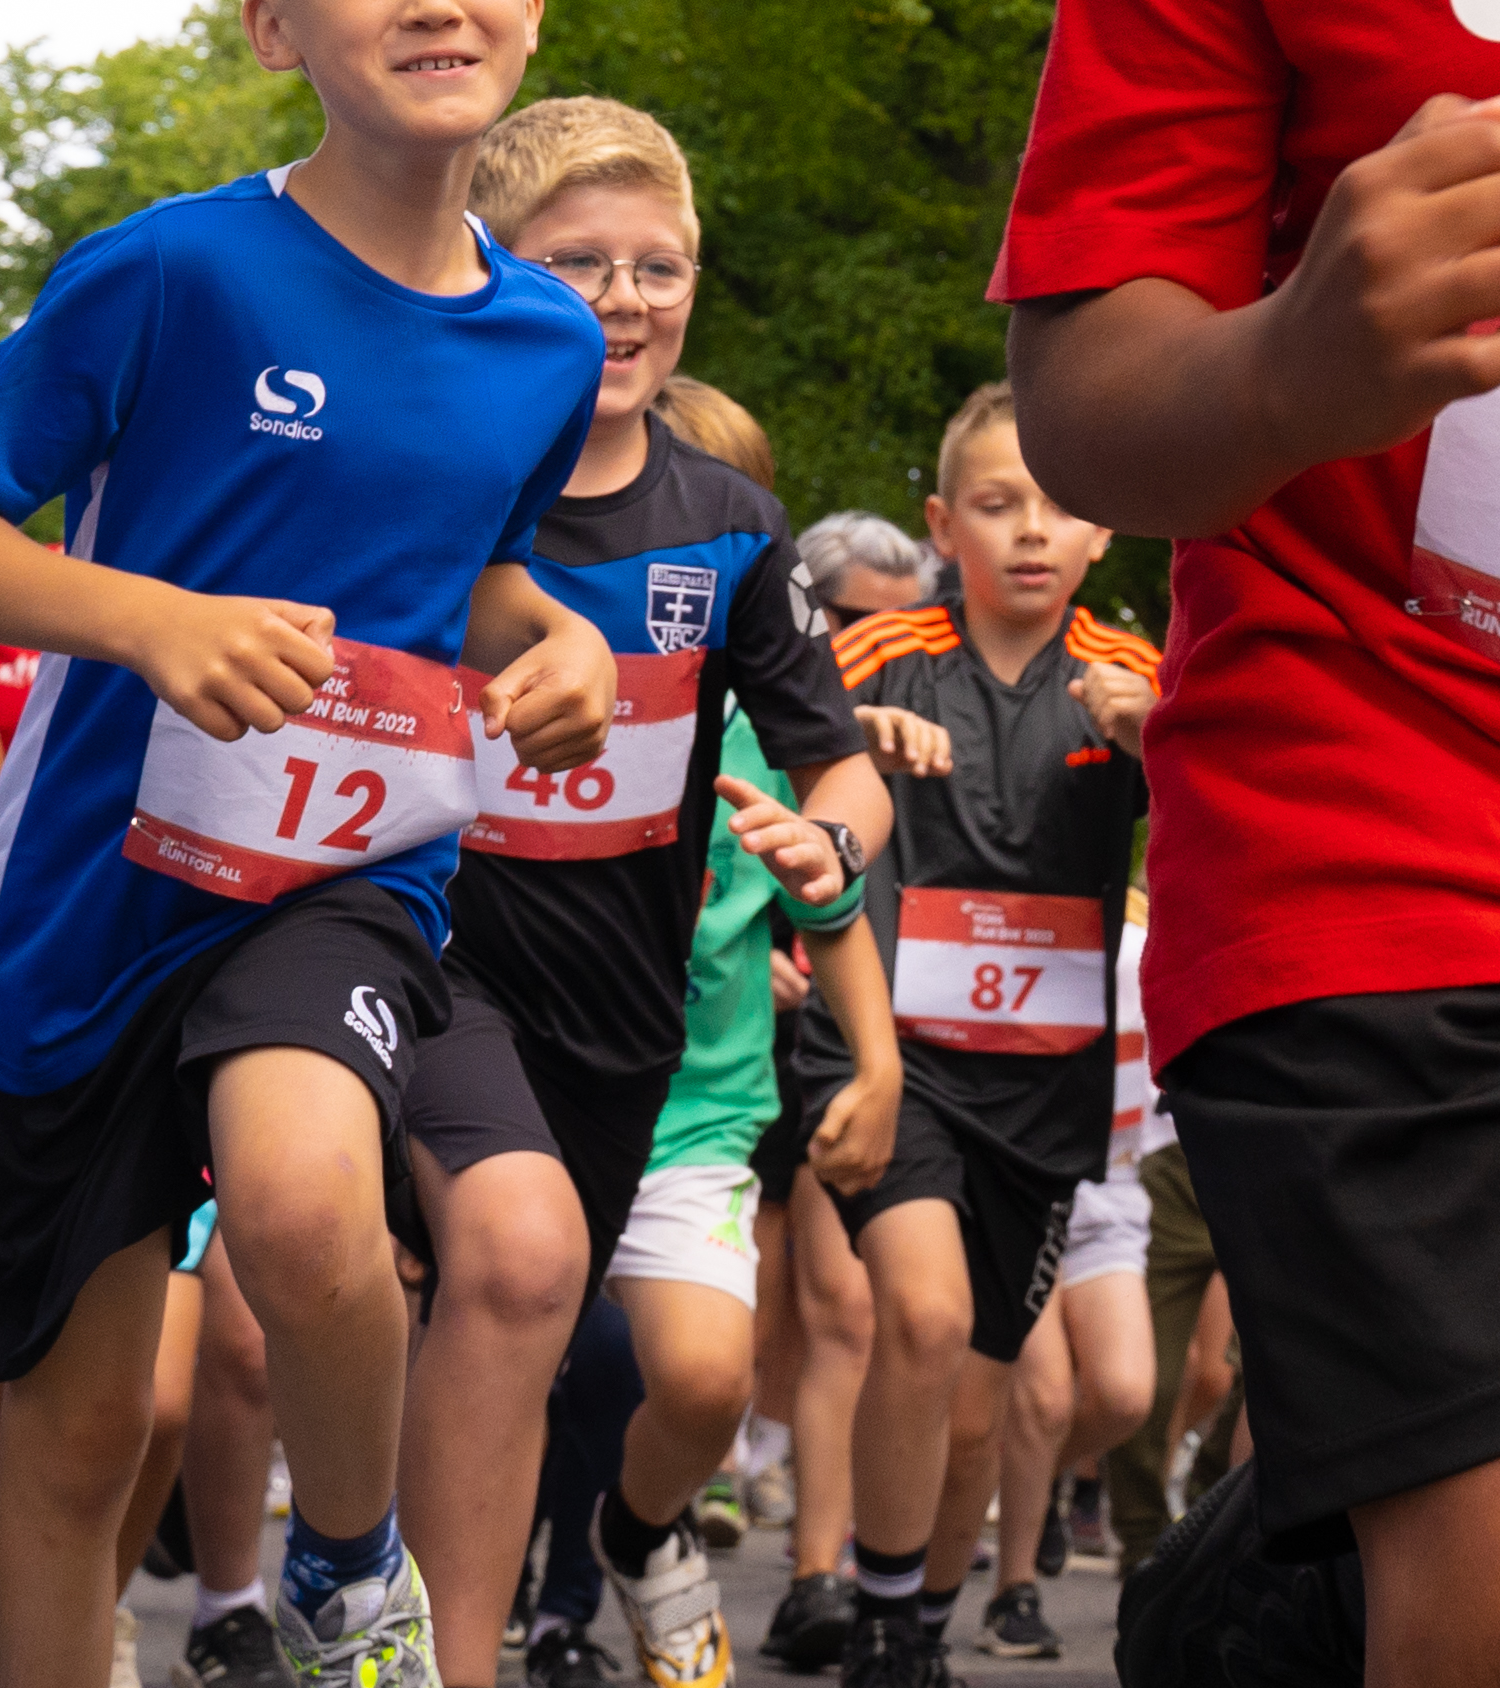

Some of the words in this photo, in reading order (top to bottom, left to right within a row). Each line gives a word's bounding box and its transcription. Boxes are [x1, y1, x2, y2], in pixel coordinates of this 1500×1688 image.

[249, 412, 323, 441] Sondico
[658, 627, 695, 651] JFC
[320, 676, 351, 698] RK
[304, 698, 332, 719] UN
[332, 702, 371, 727] RUN
[373, 711, 418, 736] 2022
[613, 700, 634, 716] 22
[504, 748, 616, 812] 46
[275, 755, 388, 853] 12
[158, 843, 188, 865] RUN
[188, 855, 215, 874] FOR
[215, 865, 242, 883] ALL
[969, 962, 1044, 1012] 87
